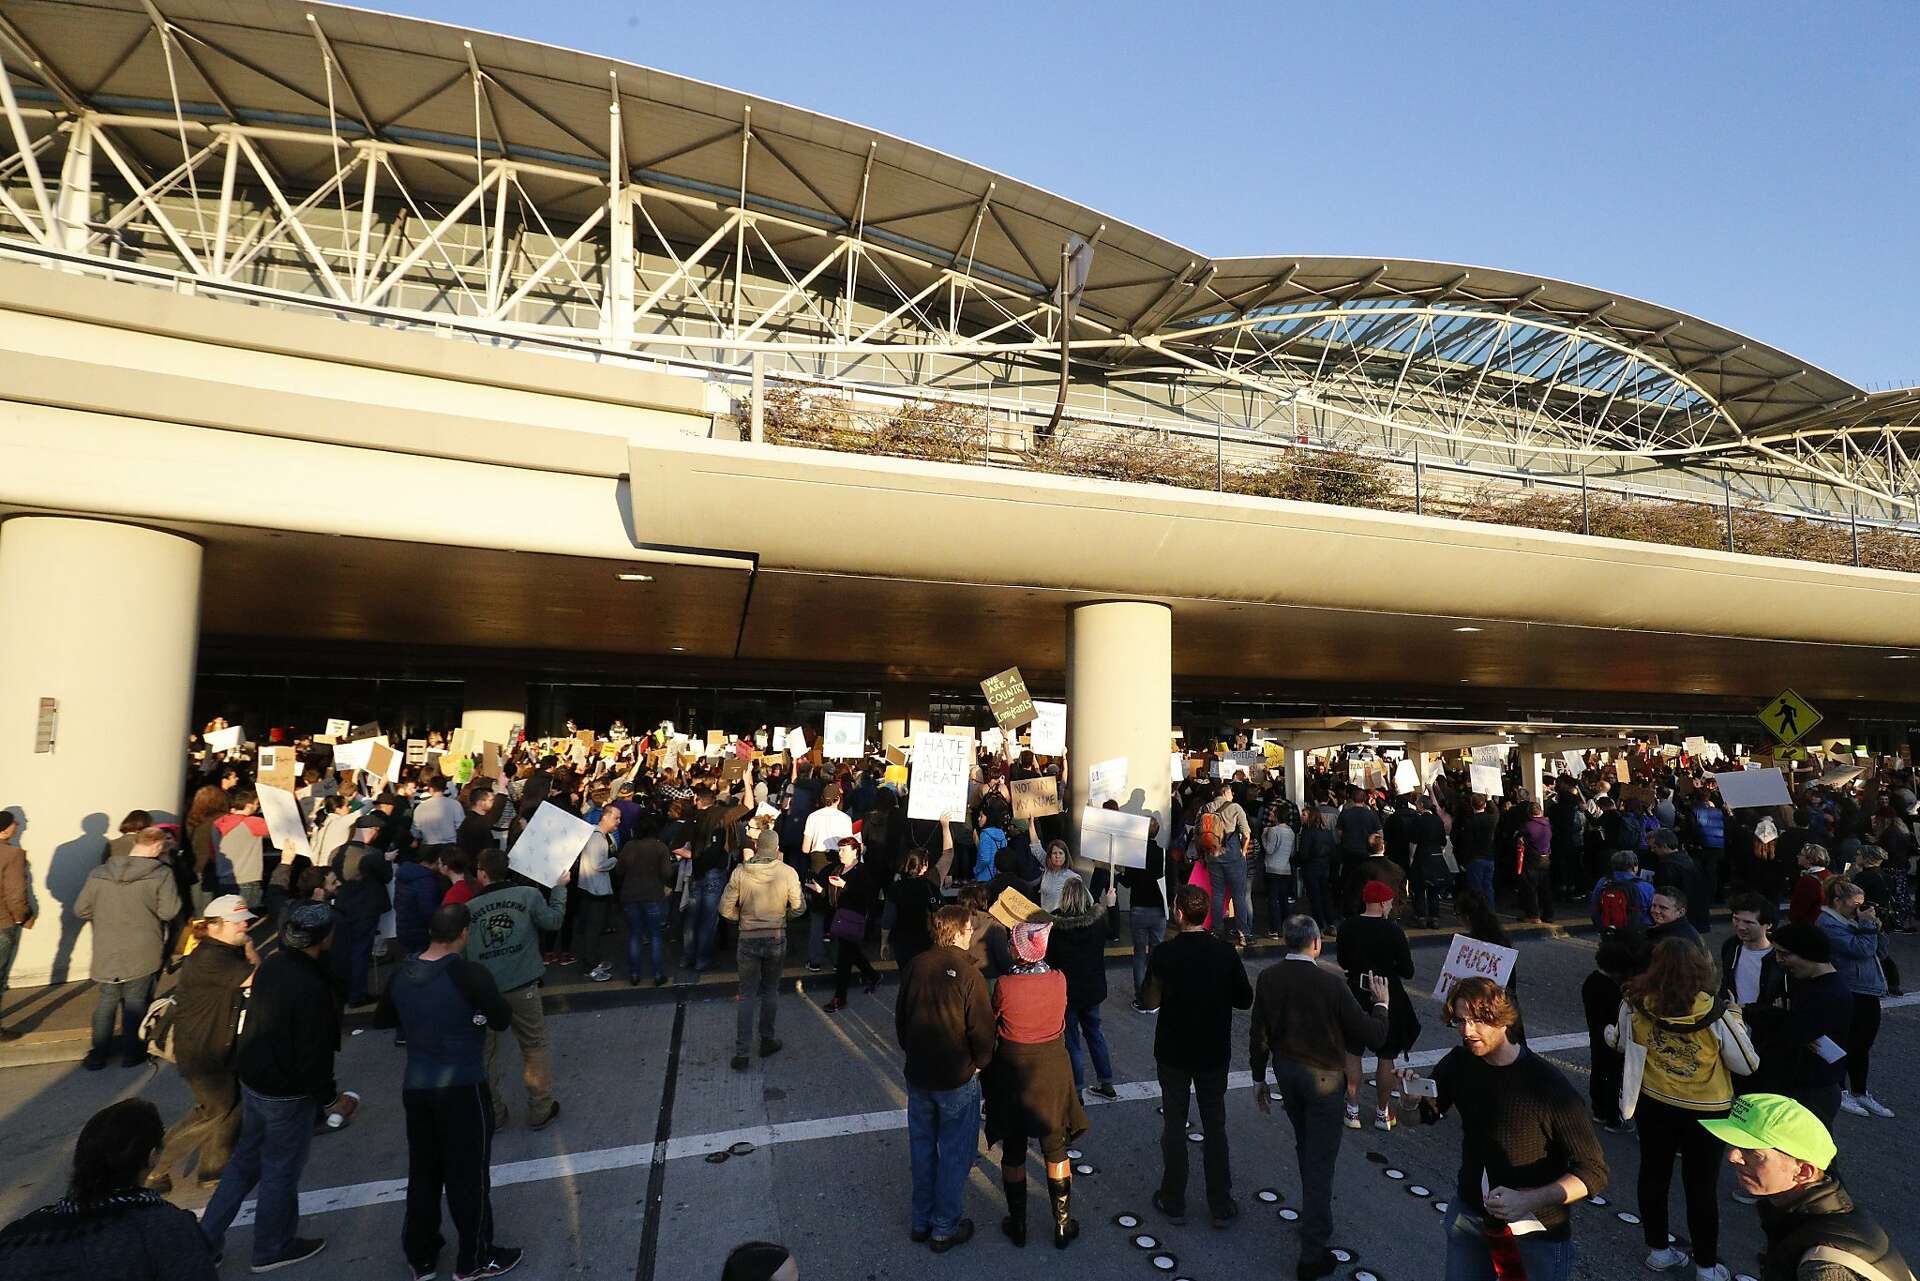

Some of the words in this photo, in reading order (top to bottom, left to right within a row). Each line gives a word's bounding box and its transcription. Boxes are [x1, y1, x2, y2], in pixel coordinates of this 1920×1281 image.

[985, 675, 1000, 687] WE
[989, 680, 1007, 694] ARE
[1009, 675, 1017, 684] A
[989, 680, 1027, 705] COUNTRY
[924, 738, 966, 755] HATE
[914, 769, 961, 785] GREAT
[1014, 781, 1032, 794] NOT
[1037, 780, 1049, 791] IN
[1033, 794, 1056, 808] NAME
[1455, 944, 1503, 977] FUCK
